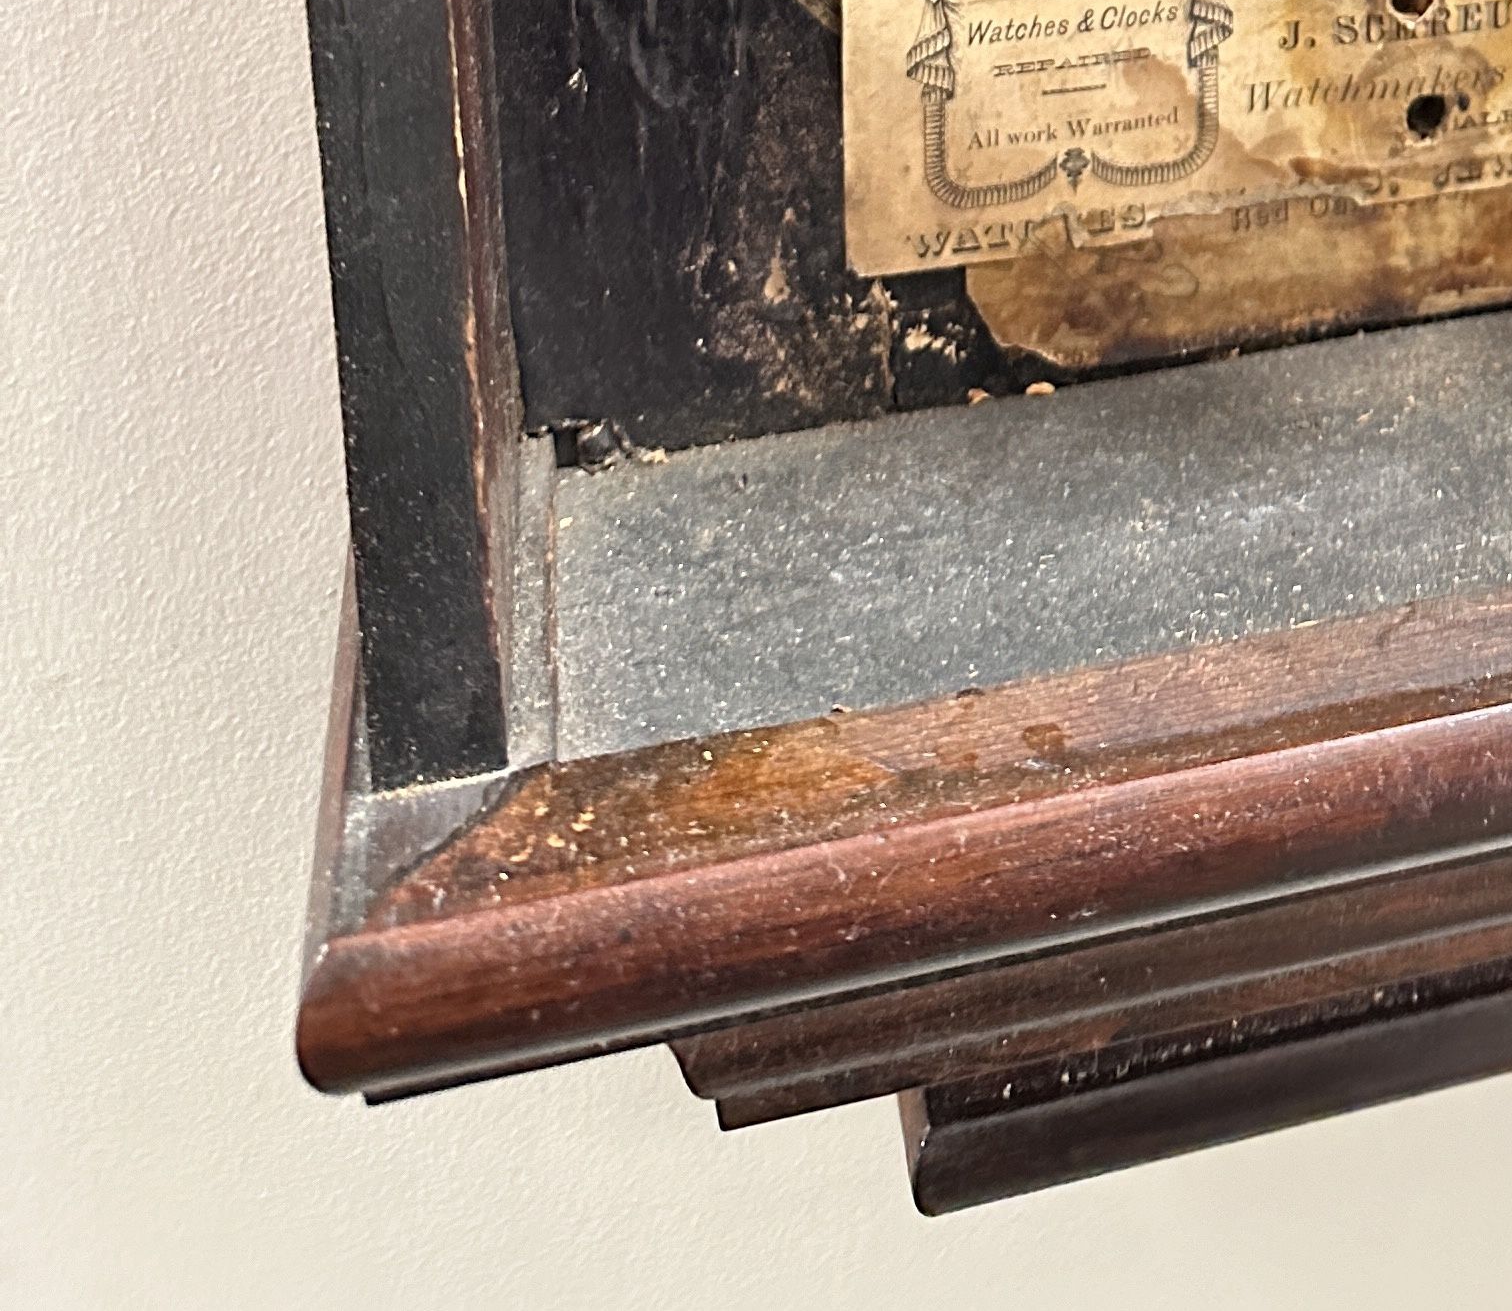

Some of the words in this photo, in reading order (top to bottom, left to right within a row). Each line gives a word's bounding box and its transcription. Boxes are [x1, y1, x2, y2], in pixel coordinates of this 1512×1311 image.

[967, 14, 1069, 47] Watches
[1076, 8, 1096, 34] &
[1100, 0, 1179, 29] Clocks
[1277, 18, 1318, 51] J.
[968, 128, 1000, 151] All
[1007, 122, 1058, 145] work
[1066, 105, 1179, 139] Warranted
